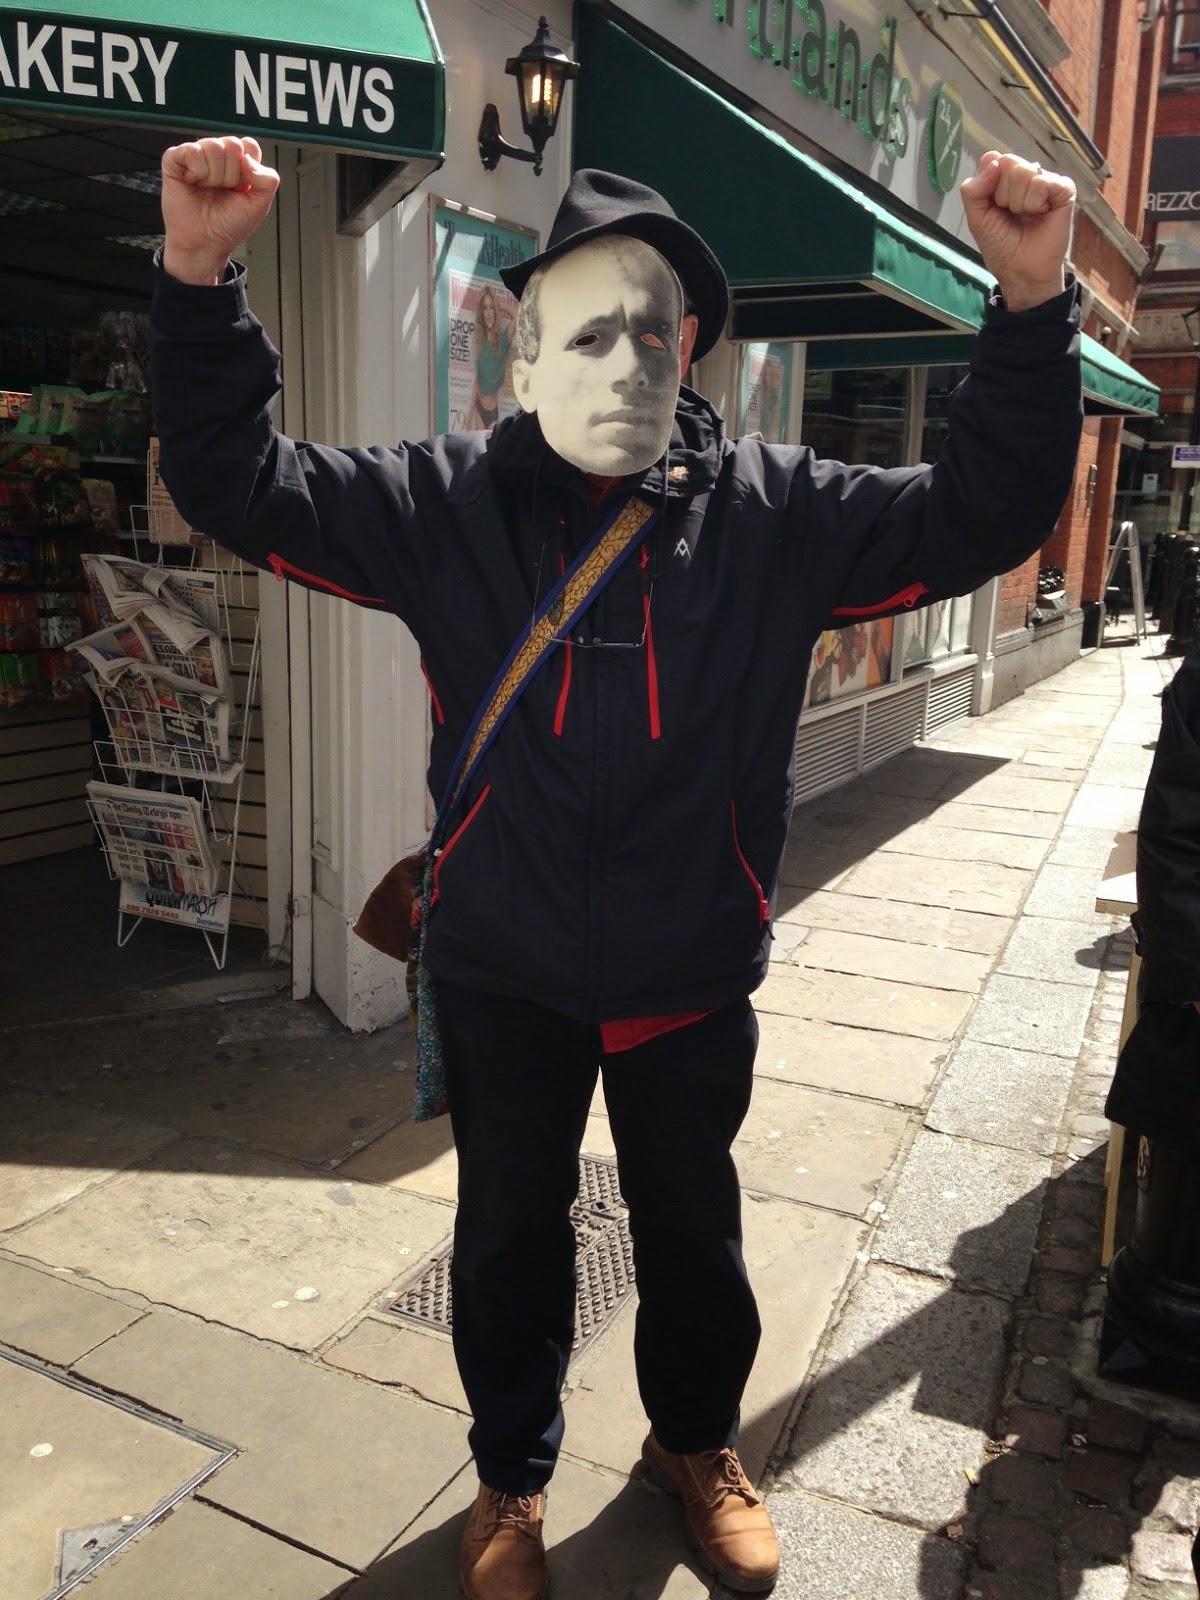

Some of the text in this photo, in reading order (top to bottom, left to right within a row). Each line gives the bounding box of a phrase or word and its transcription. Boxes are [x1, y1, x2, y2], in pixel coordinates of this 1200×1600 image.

[234, 49, 395, 134] NEWS
[449, 318, 475, 335] DROP
[449, 333, 469, 349] ONE
